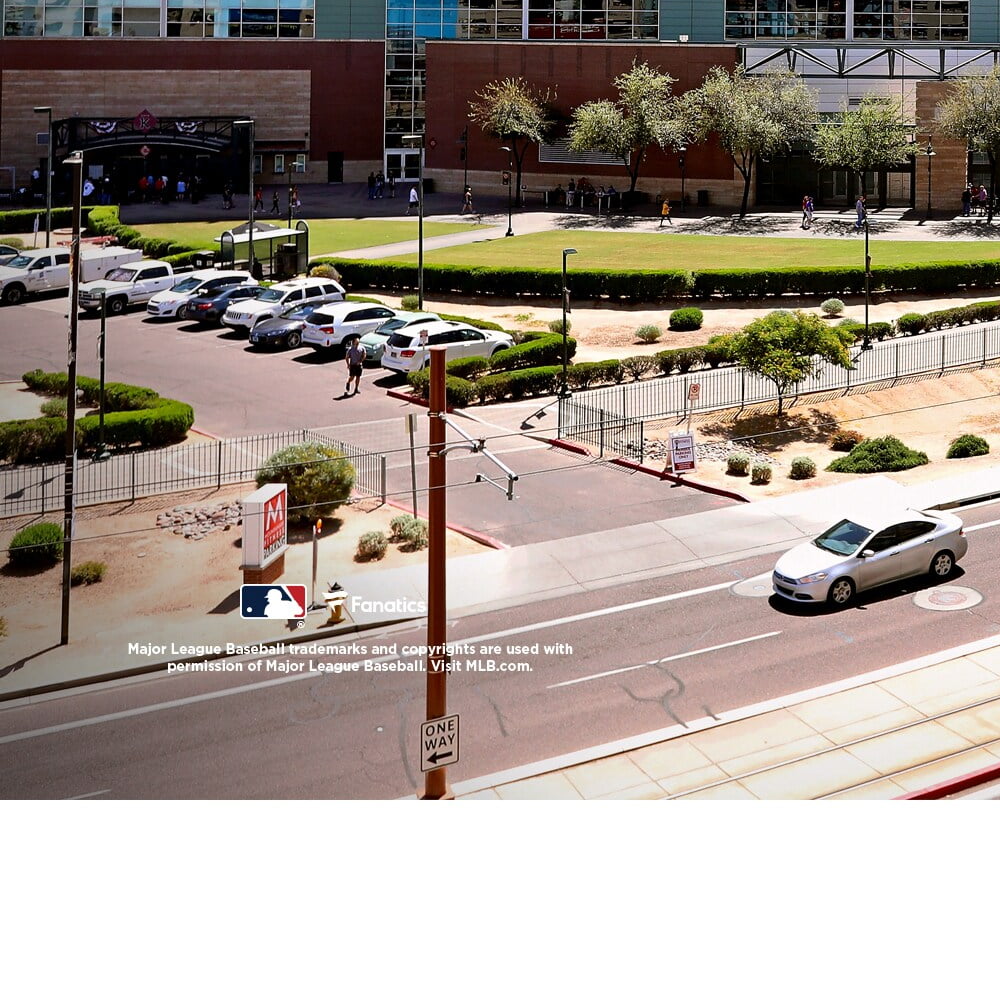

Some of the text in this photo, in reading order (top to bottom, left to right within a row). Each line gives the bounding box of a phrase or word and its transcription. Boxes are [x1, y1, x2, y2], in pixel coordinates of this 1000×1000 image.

[266, 494, 284, 532] M
[425, 719, 455, 737] ONE
[425, 733, 456, 751] WAY
